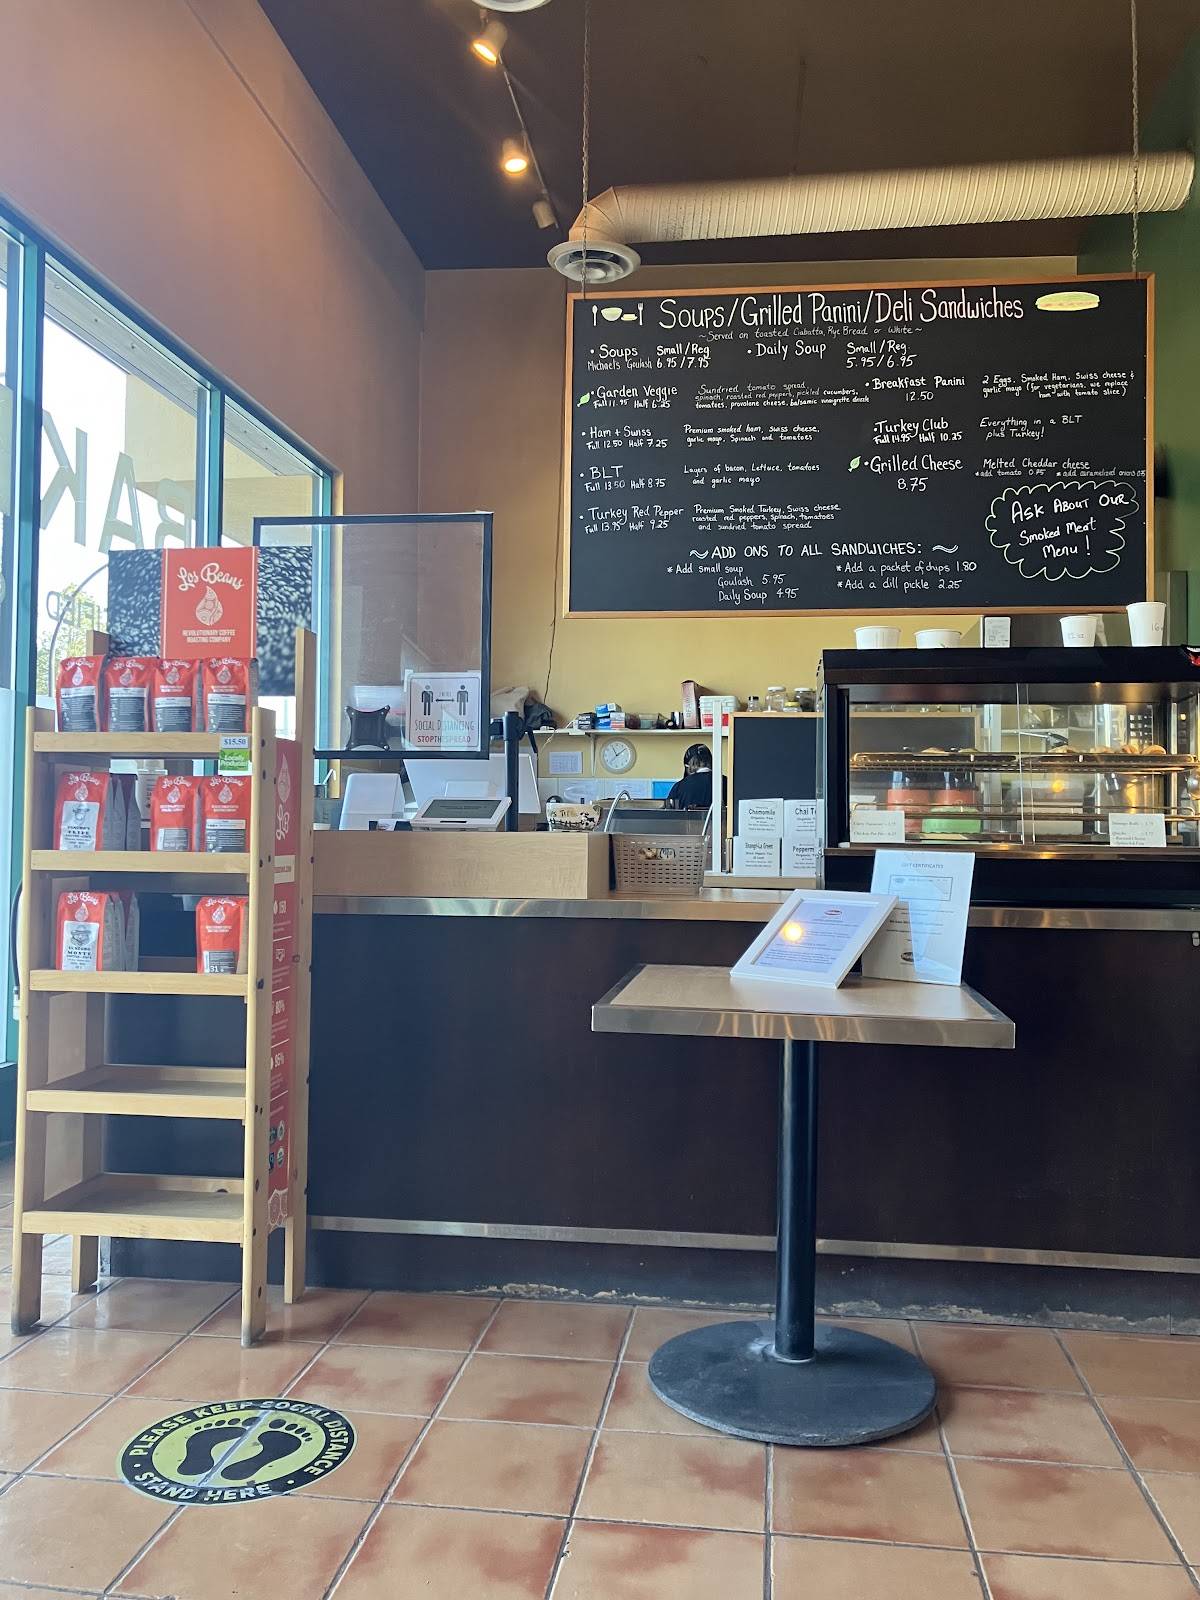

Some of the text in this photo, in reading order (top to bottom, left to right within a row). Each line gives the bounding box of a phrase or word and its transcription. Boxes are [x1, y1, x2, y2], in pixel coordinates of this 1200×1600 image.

[658, 286, 1023, 329] Soups/Grilled Panini/Deli Sandwiches
[739, 332, 749, 340] on
[754, 328, 789, 339] toasted
[828, 326, 841, 340] Rye
[842, 325, 868, 336] Bread
[599, 344, 638, 362] Soups
[755, 339, 827, 361] Daily Soup
[872, 375, 965, 390] Breakfast Panini
[1021, 370, 1127, 383] Smoked Swiss cheese
[596, 385, 679, 402] Garden Veggie
[747, 382, 776, 392] tomato
[982, 384, 1001, 398] garlic
[1104, 378, 1129, 389] replace
[1074, 388, 1099, 397] tomato
[755, 391, 767, 400] red
[905, 390, 934, 402] 12.50
[683, 424, 714, 435] Premium
[717, 424, 743, 435] smoked
[875, 417, 949, 438] Turkey Club
[980, 414, 1083, 433] Everything in BLT
[590, 425, 652, 439] Ham Swiss
[873, 431, 963, 445] Full Half 10.25
[985, 426, 1045, 441] plus Turkey!
[586, 438, 668, 451] Full 12.50 Half 7.25
[686, 436, 704, 448] garlic
[761, 435, 774, 443] and
[779, 434, 813, 444] tomatoes
[684, 465, 708, 478] Layers
[713, 464, 721, 474] of
[787, 462, 820, 473] tomatoes
[870, 454, 964, 475] Grilled Cheese
[982, 457, 1091, 469] Melted Cheddar cheese
[589, 465, 623, 480] BLT
[997, 468, 1022, 477] tomato
[584, 481, 600, 492] Full
[630, 478, 645, 490] Half
[647, 478, 667, 489] 8.75
[692, 475, 761, 489] and garlic mayo
[897, 477, 928, 492] 8.75
[587, 505, 684, 525] Turkey Red Pepper
[693, 503, 810, 515] Premium Smoked Swiss
[692, 513, 717, 523] roasted
[723, 513, 736, 522] red
[799, 511, 835, 522] tomatoes
[585, 523, 598, 534] Full
[629, 521, 645, 533] Half
[649, 519, 670, 532] 9.25
[698, 519, 813, 533] and sundried tomato spread
[1019, 526, 1061, 547] Smoked
[711, 542, 922, 559] ADD ONS TO ALL SANDWICHES:
[698, 562, 721, 573] small
[725, 565, 744, 577] soup
[868, 565, 876, 573] a
[880, 561, 911, 577] packet
[914, 560, 926, 575] of
[177, 562, 245, 591] Los Beans
[717, 573, 787, 589] Goulash 5.95
[868, 581, 877, 590] a
[882, 576, 899, 590] dill
[903, 578, 930, 594] pickle
[937, 578, 964, 592] 2.25
[718, 587, 799, 606] Daily Soup 4.95
[792, 845, 815, 853] Pepperm
[129, 1400, 349, 1477] PLEASE KEEP SOCIAL DISTANCE
[134, 1470, 273, 1502] STAND HERE
